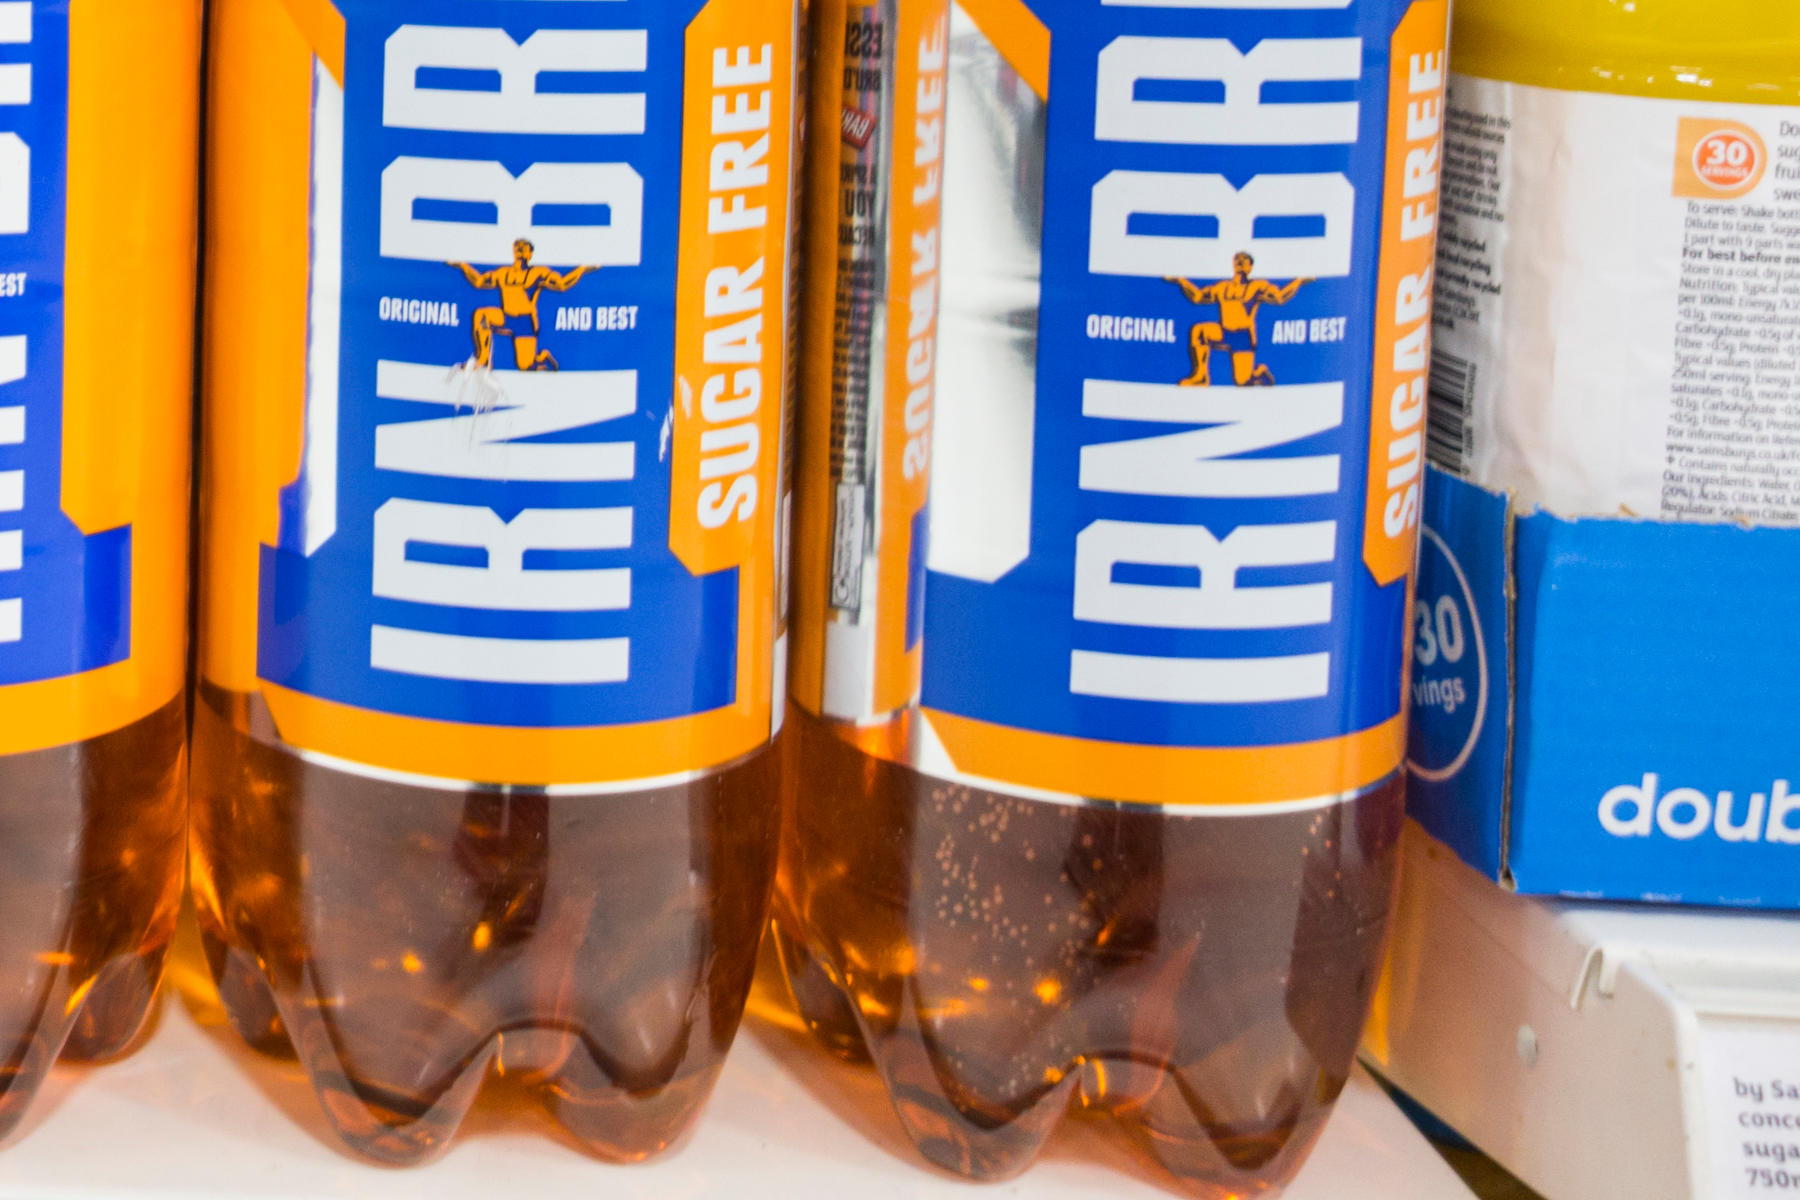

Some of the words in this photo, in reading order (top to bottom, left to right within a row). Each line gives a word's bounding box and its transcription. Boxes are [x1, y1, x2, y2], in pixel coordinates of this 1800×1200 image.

[708, 43, 773, 234] FREE
[1400, 48, 1444, 242] FREE
[1707, 139, 1747, 166] 30
[1688, 201, 1699, 213] To
[1742, 205, 1773, 218] Shake
[1685, 218, 1718, 229] Dilute
[1723, 220, 1733, 229] to
[1691, 234, 1714, 245] part
[1718, 236, 1742, 245] with
[1681, 263, 1709, 274] Store
[1682, 248, 1703, 258] For
[1708, 249, 1735, 260] best
[1740, 251, 1780, 263] before
[379, 297, 459, 327] ORIGINAL
[556, 307, 591, 330] AND
[596, 306, 638, 330] BEST
[1678, 295, 1697, 306] per
[1086, 314, 1176, 343] ORIGINAL
[1272, 321, 1307, 344] AND
[1309, 317, 1346, 342] BEST
[697, 256, 765, 529] SUGAR
[1384, 263, 1432, 539] SUGAR
[1663, 470, 1683, 482] Our
[370, 358, 637, 684] IRN
[1070, 377, 1344, 703] IRN
[1733, 1077, 1763, 1103] by
